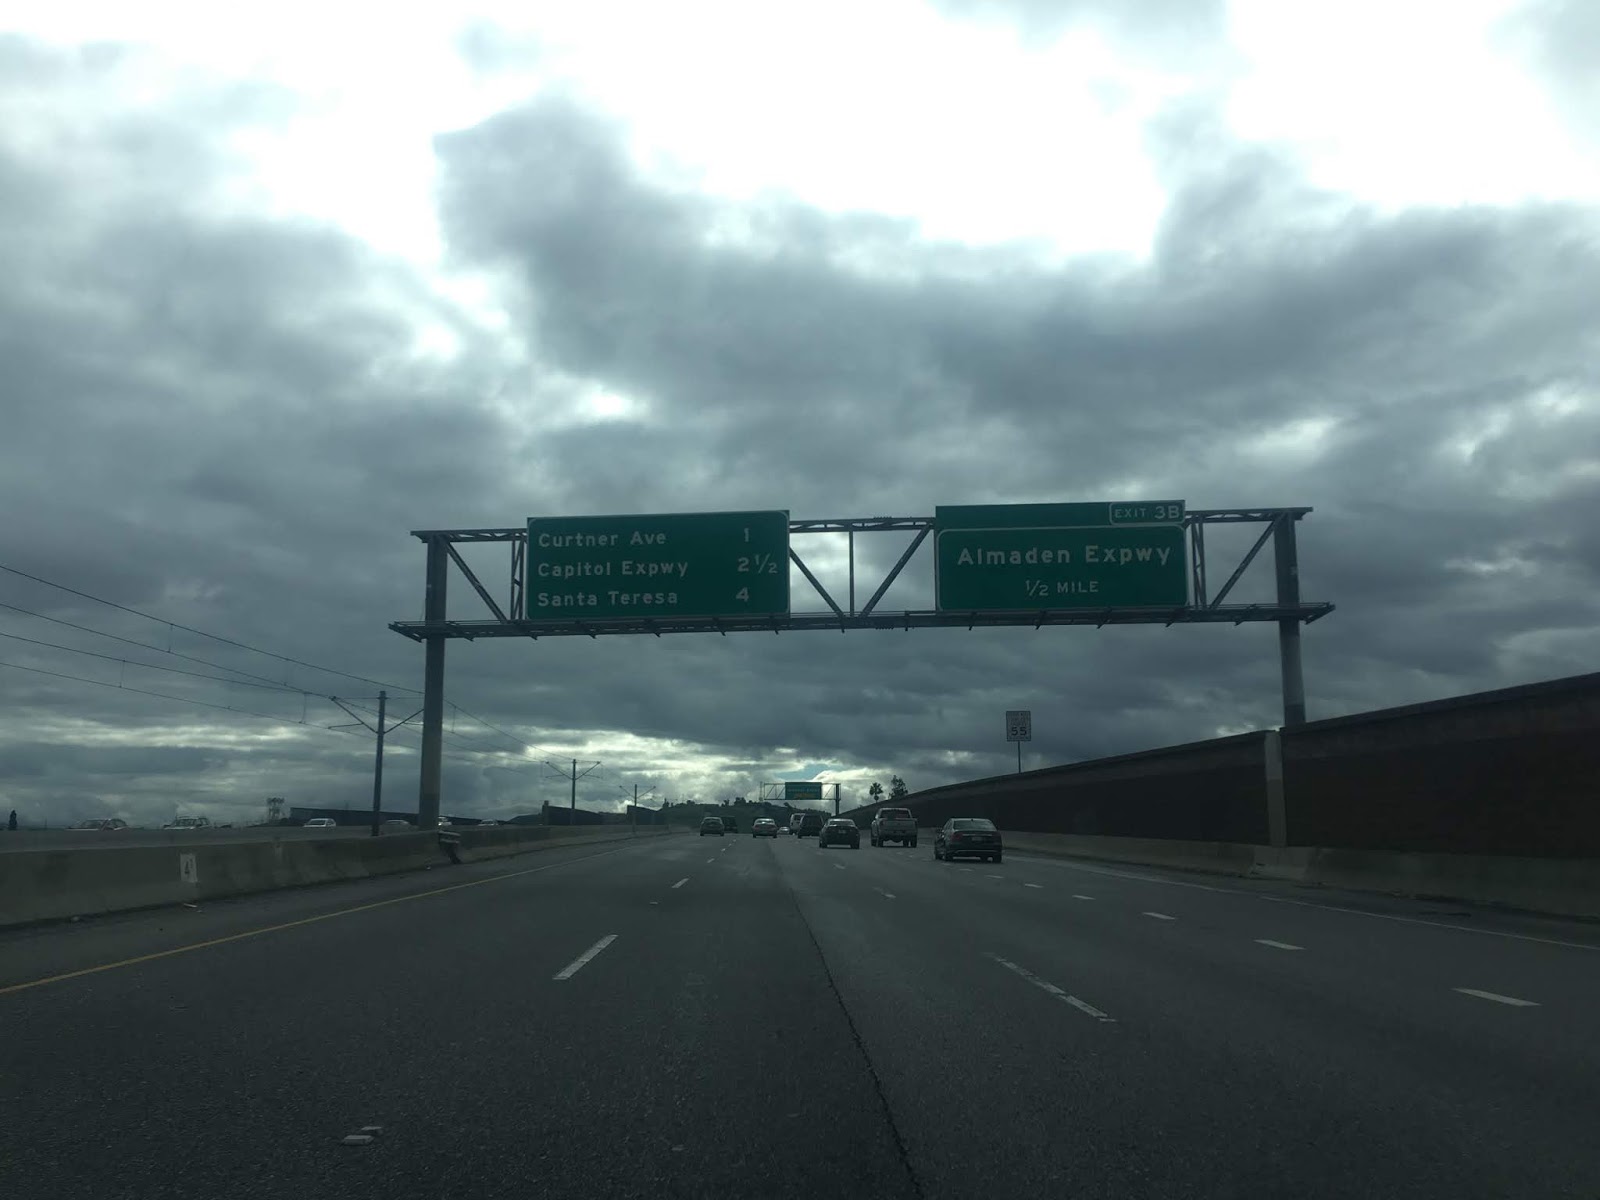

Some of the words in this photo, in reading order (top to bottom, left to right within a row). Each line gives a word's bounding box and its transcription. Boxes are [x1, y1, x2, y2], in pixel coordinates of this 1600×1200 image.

[1114, 507, 1147, 519] EXIT
[1153, 504, 1180, 519] 3B
[538, 531, 618, 548] Curtner
[629, 530, 667, 546] Ave
[743, 527, 750, 542] 1
[957, 546, 1070, 565] Almaden
[1085, 545, 1170, 566] Expwy
[537, 561, 612, 580] Capitol
[621, 560, 689, 578] Expwy
[537, 591, 598, 607] Santa
[608, 590, 678, 606] Teresa
[735, 586, 750, 602] 4
[1056, 580, 1099, 594] MILE
[1011, 726, 1027, 736] 55
